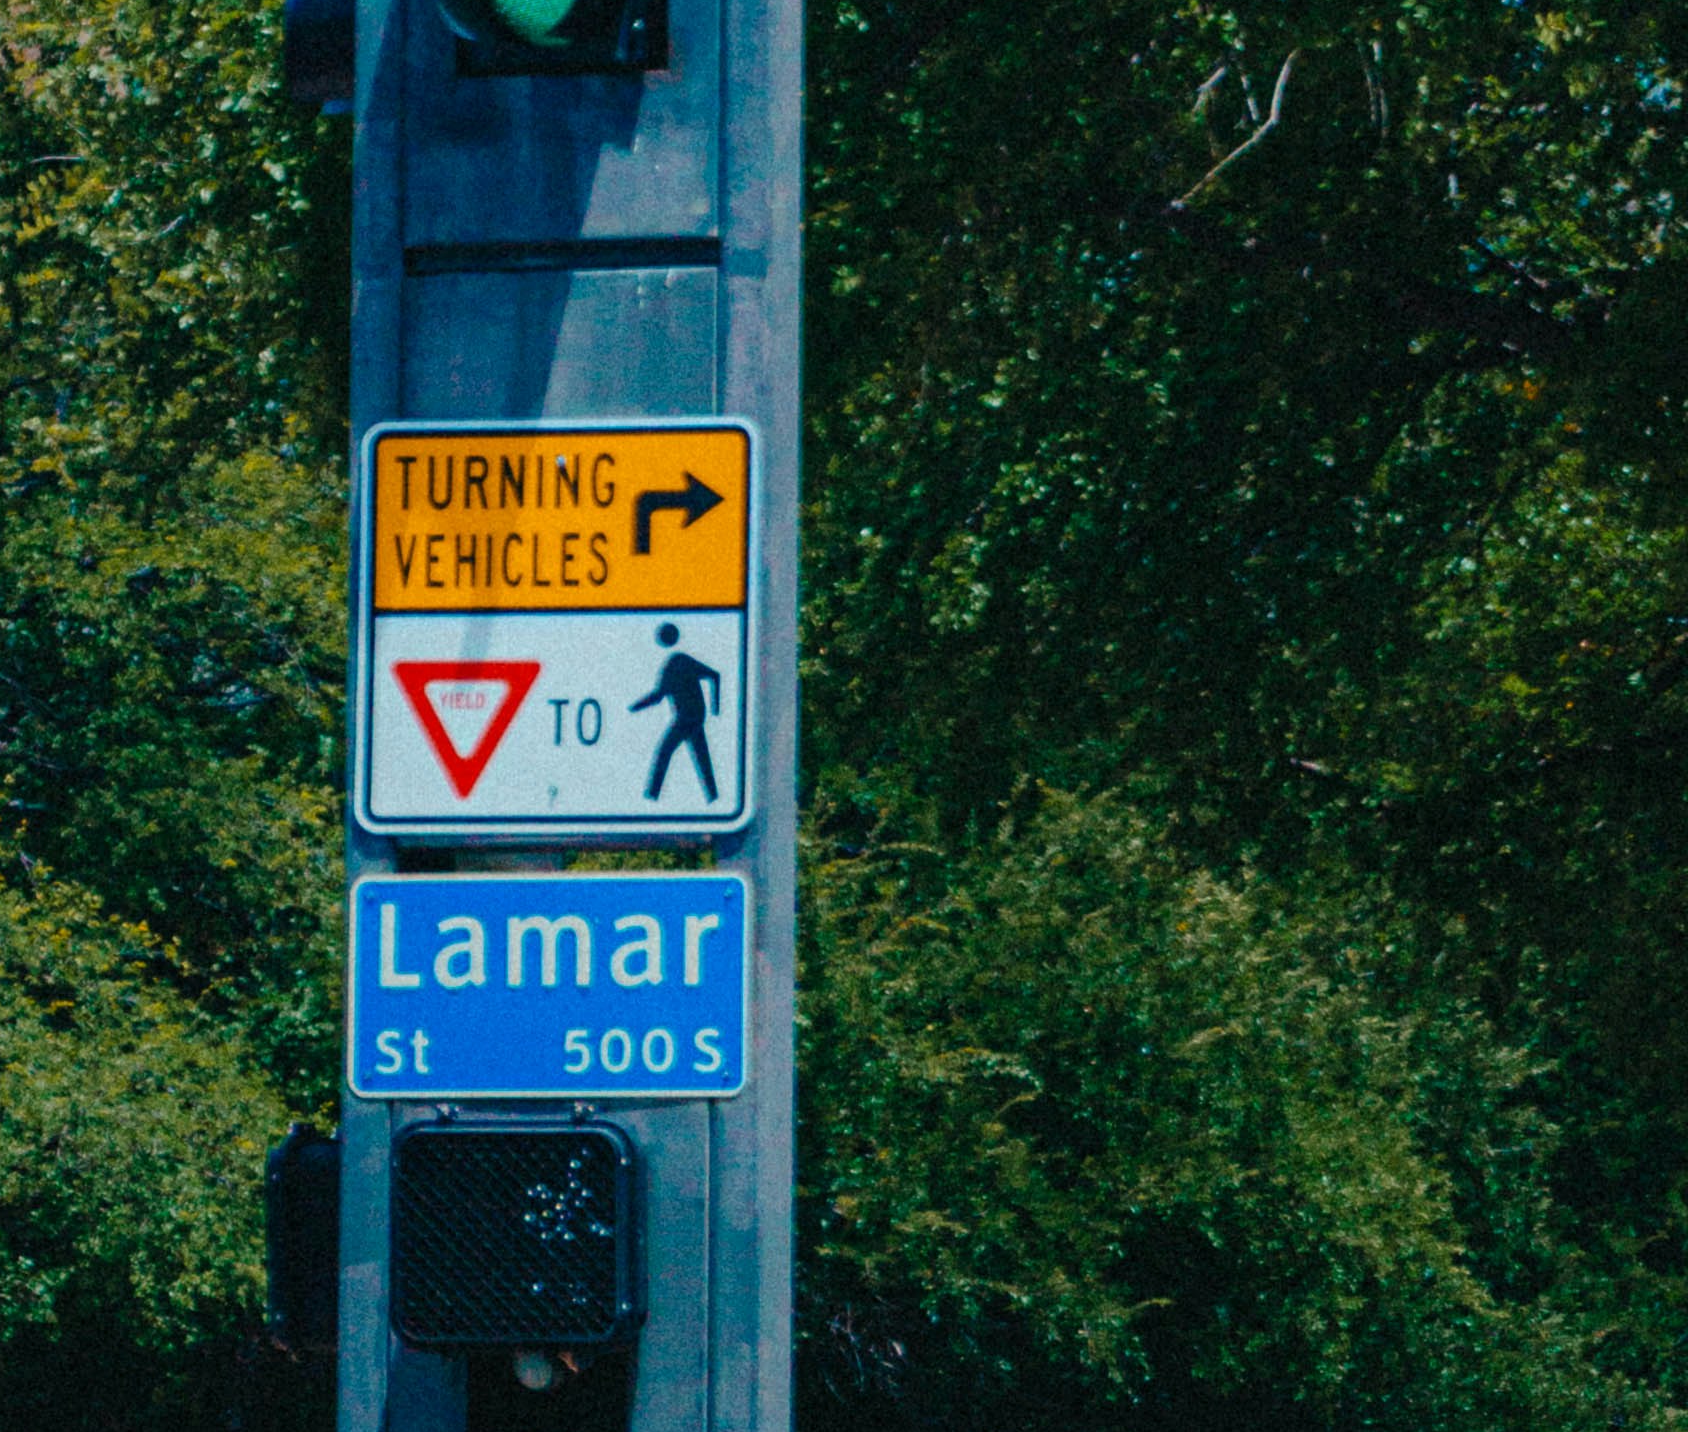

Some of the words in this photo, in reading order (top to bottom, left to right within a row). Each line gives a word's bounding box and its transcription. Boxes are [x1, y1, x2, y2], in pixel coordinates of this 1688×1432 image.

[394, 453, 616, 511] TURNING
[394, 532, 610, 588] VEHICLES
[440, 692, 486, 710] YIELD
[547, 696, 603, 748] TO
[379, 903, 720, 988] Lamar
[376, 1030, 430, 1074] St
